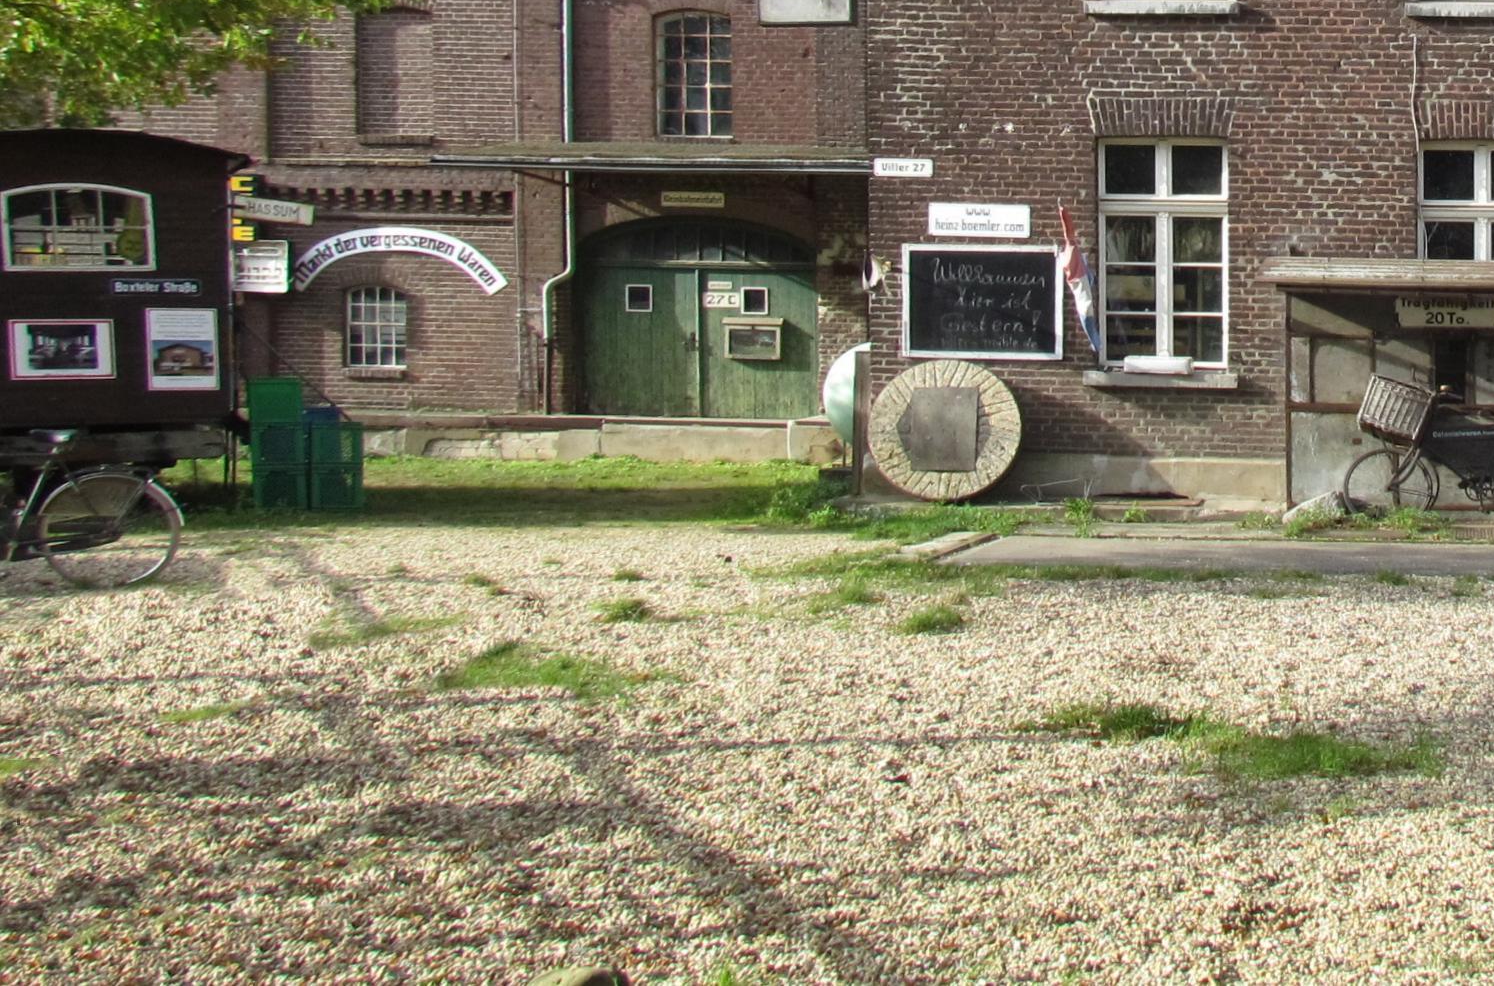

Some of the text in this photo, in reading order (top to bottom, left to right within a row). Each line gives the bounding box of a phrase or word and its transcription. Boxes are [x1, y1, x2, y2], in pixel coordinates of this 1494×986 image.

[881, 162, 926, 172] Viller 27
[246, 200, 300, 218] HASSUM
[295, 242, 334, 283] Markt
[334, 236, 357, 254] der
[456, 247, 497, 287] Waren
[114, 281, 198, 294] Boxteler Straße
[707, 295, 725, 305] 27
[1401, 297, 1494, 310] Tragfähigkeit
[1425, 312, 1444, 324] 20
